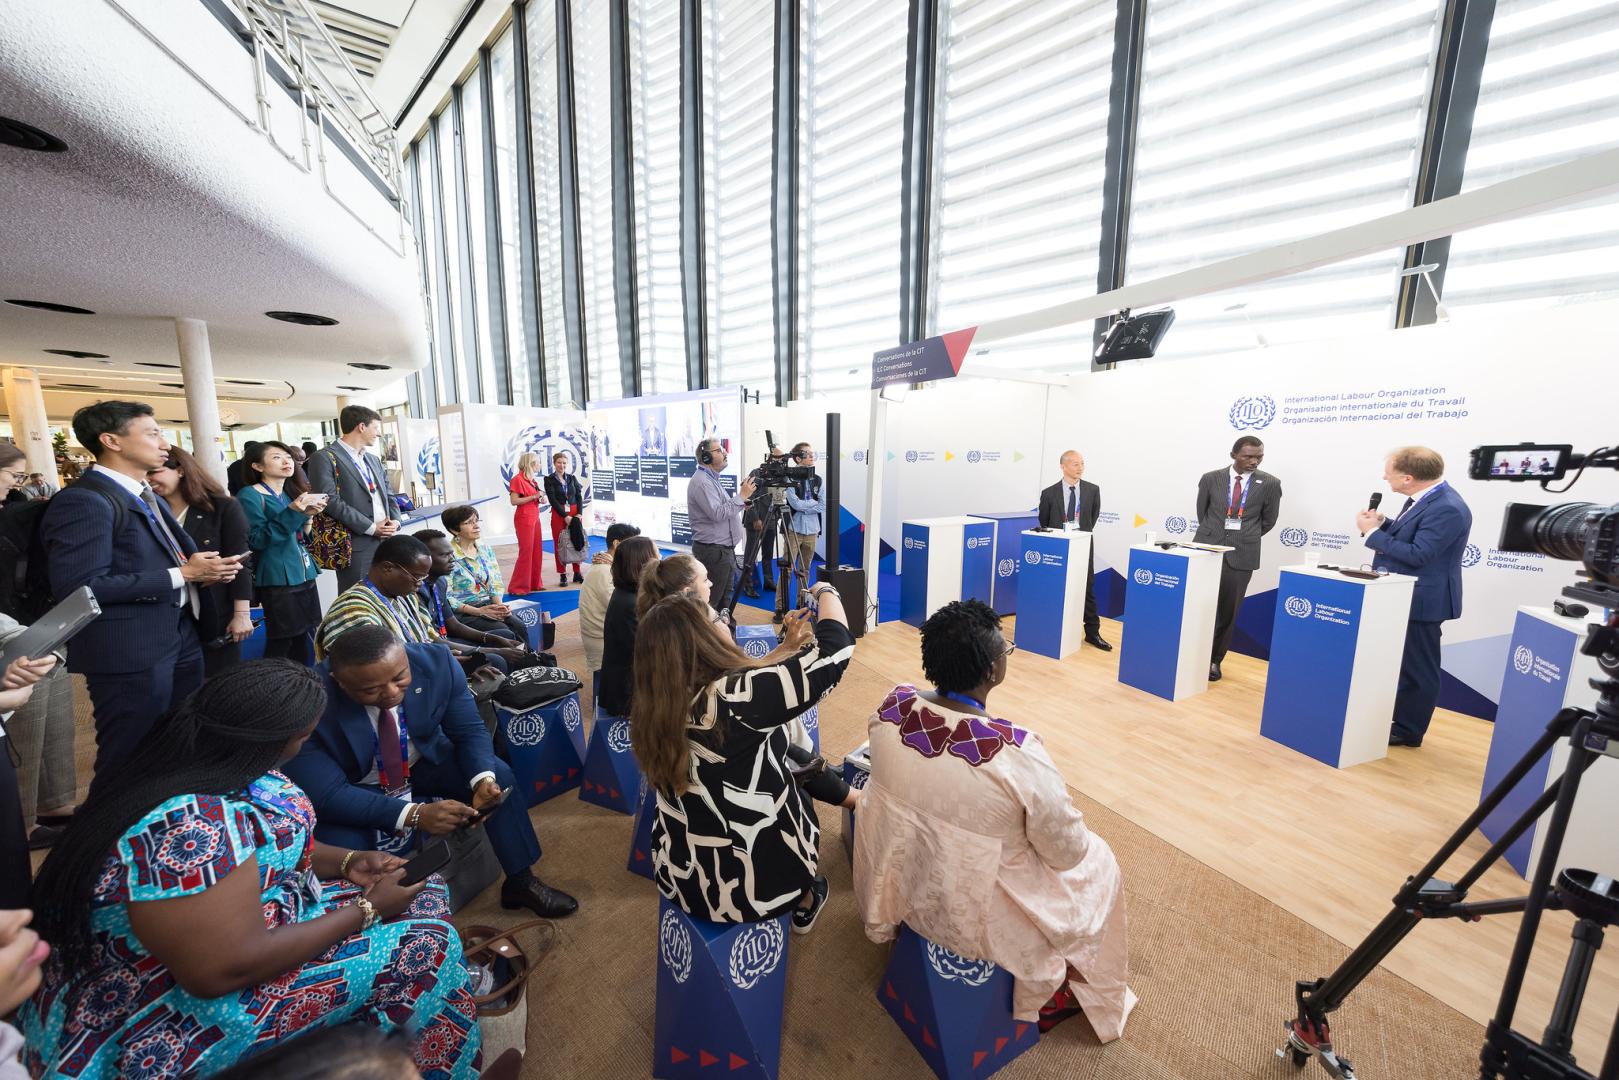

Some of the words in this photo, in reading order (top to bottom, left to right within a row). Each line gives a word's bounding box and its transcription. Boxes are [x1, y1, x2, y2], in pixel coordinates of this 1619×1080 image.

[883, 361, 912, 372] Conversations
[1284, 394, 1339, 404] International
[1341, 391, 1375, 401] Labour
[1377, 387, 1446, 398] Organization
[1243, 403, 1263, 420] ILO
[1283, 404, 1338, 415] Organisation
[1410, 400, 1424, 408] du
[1428, 397, 1466, 406] Travail
[1281, 414, 1338, 425] Organización
[1340, 412, 1404, 422] Internacional
[1406, 411, 1423, 419] del
[1426, 409, 1469, 419] Trabajo
[1312, 531, 1351, 539] Organización
[1312, 537, 1350, 545] Internacional
[1321, 542, 1342, 550] Trabajo
[1487, 555, 1519, 563] Labour
[1486, 560, 1544, 572] Organization
[1293, 600, 1305, 612] ILO
[1315, 603, 1352, 615] International
[1315, 608, 1335, 617] Labour
[1314, 613, 1350, 625] Organization
[751, 644, 763, 655] ILO
[518, 720, 535, 736] ILO
[668, 926, 687, 958] OIT
[745, 933, 769, 966] ILO
